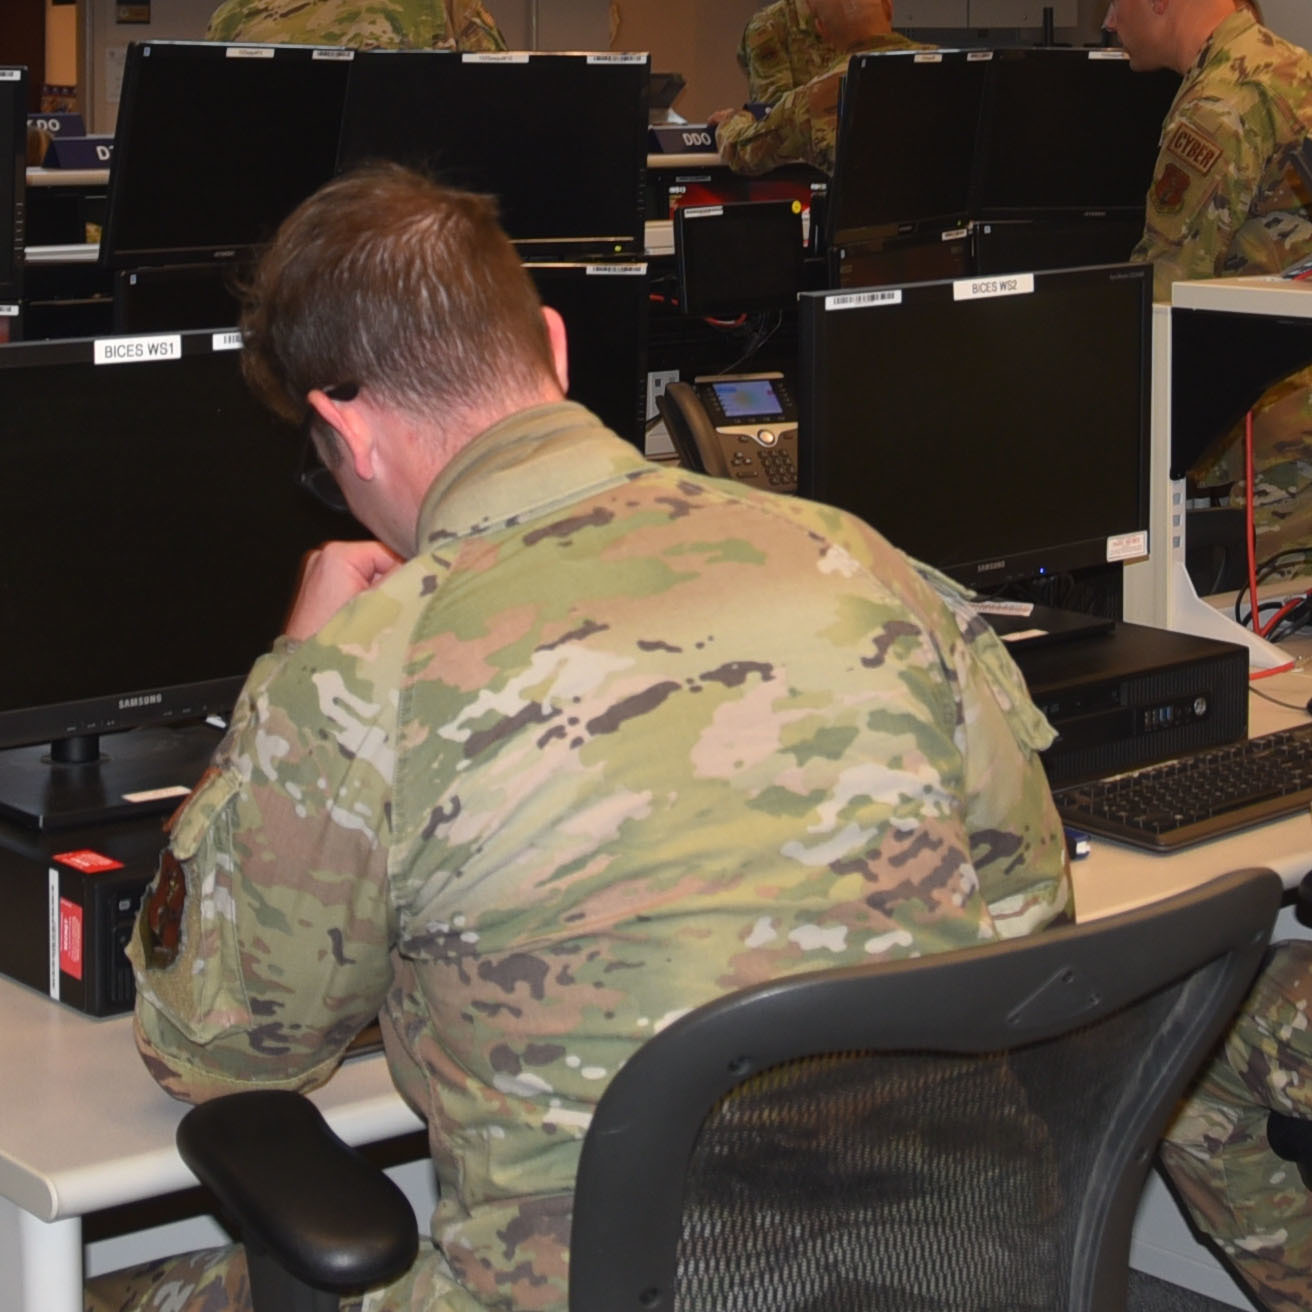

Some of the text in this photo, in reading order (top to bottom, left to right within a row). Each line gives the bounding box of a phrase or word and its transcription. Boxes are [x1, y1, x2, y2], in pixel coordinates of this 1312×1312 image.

[682, 133, 711, 146] DDO
[1174, 131, 1215, 169] CYBER
[972, 279, 1018, 295] BICES WS2
[104, 342, 174, 359] BICES WS1
[119, 693, 162, 710] SAMSUNG
